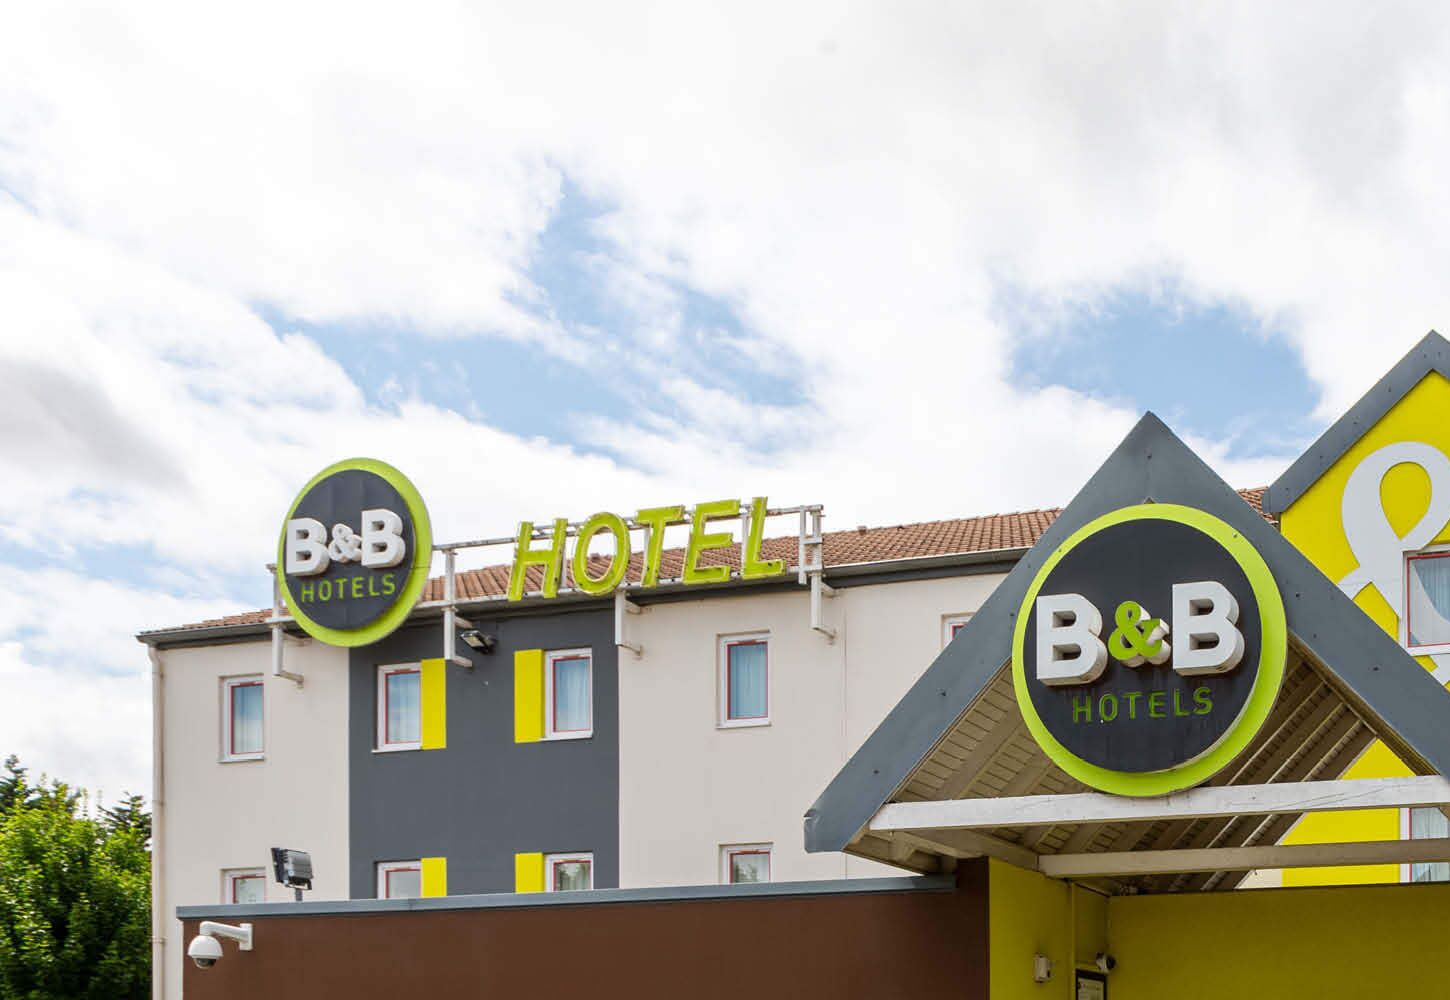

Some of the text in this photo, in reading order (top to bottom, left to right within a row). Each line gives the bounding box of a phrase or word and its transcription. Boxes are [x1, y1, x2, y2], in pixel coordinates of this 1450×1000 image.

[286, 508, 406, 577] B&B
[507, 496, 787, 602] HOTEL
[301, 573, 396, 603] HOTELS
[1036, 580, 1245, 687] B&B
[1072, 686, 1214, 724] HOTELS
